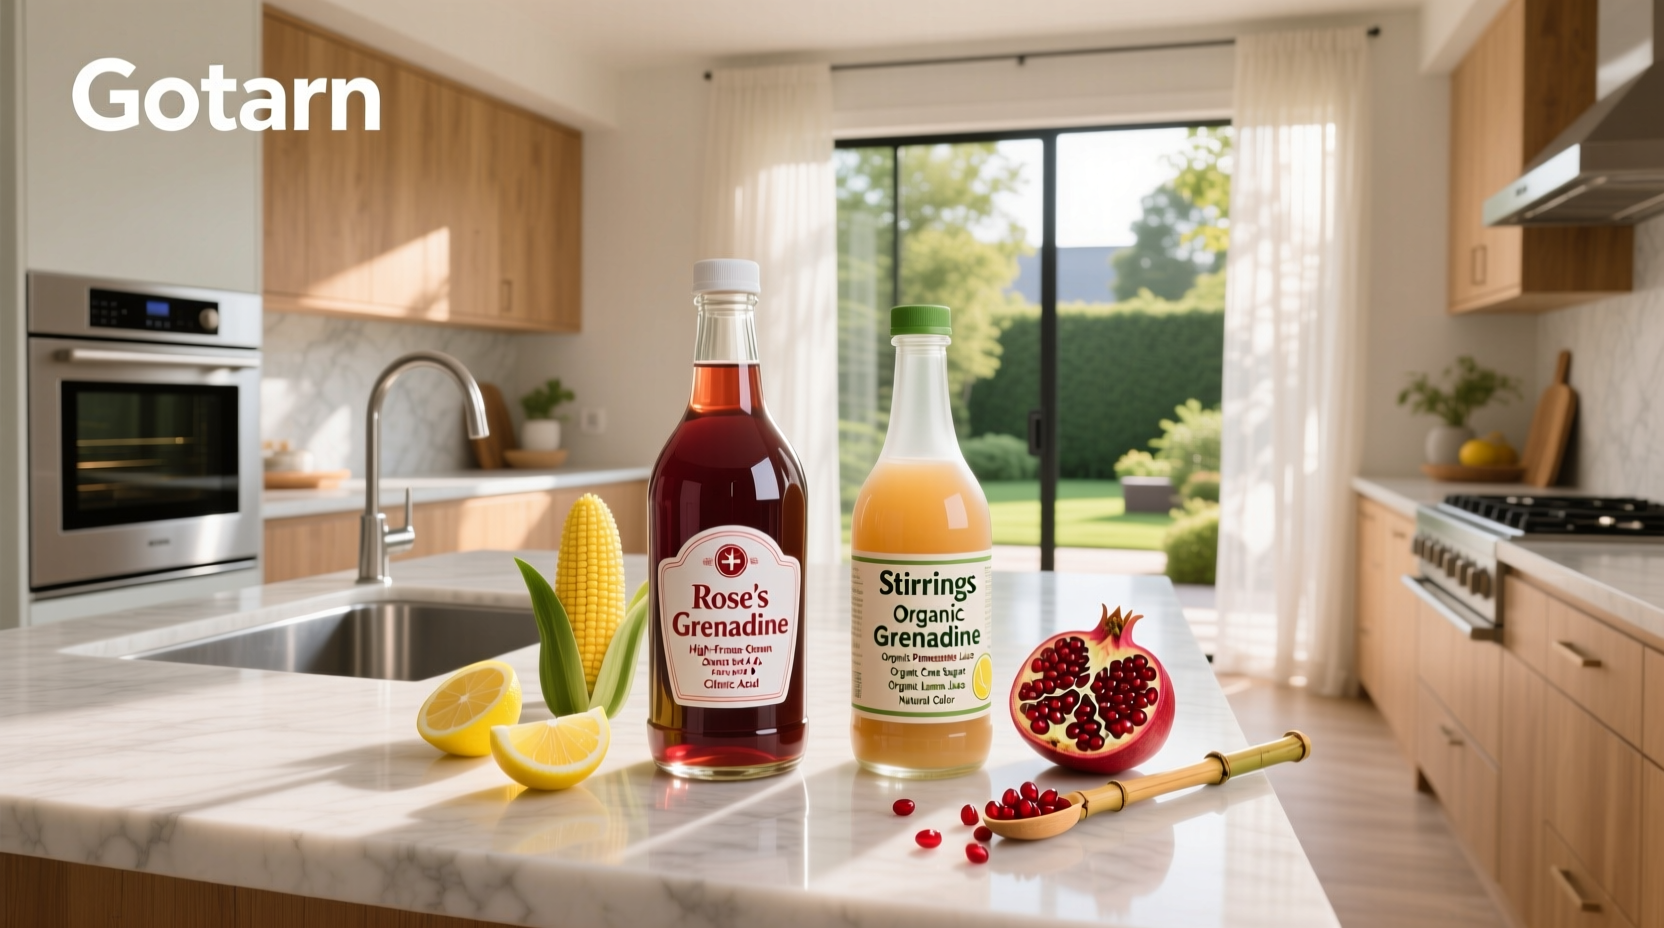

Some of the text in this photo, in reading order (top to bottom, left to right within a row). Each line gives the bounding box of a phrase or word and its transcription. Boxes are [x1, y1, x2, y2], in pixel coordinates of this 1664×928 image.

[692, 583, 769, 610] Rose's
[879, 570, 977, 602] Stirrings
[672, 611, 789, 638] Grenadine
[893, 603, 965, 628] Organic
[873, 625, 981, 648] Grenadine
